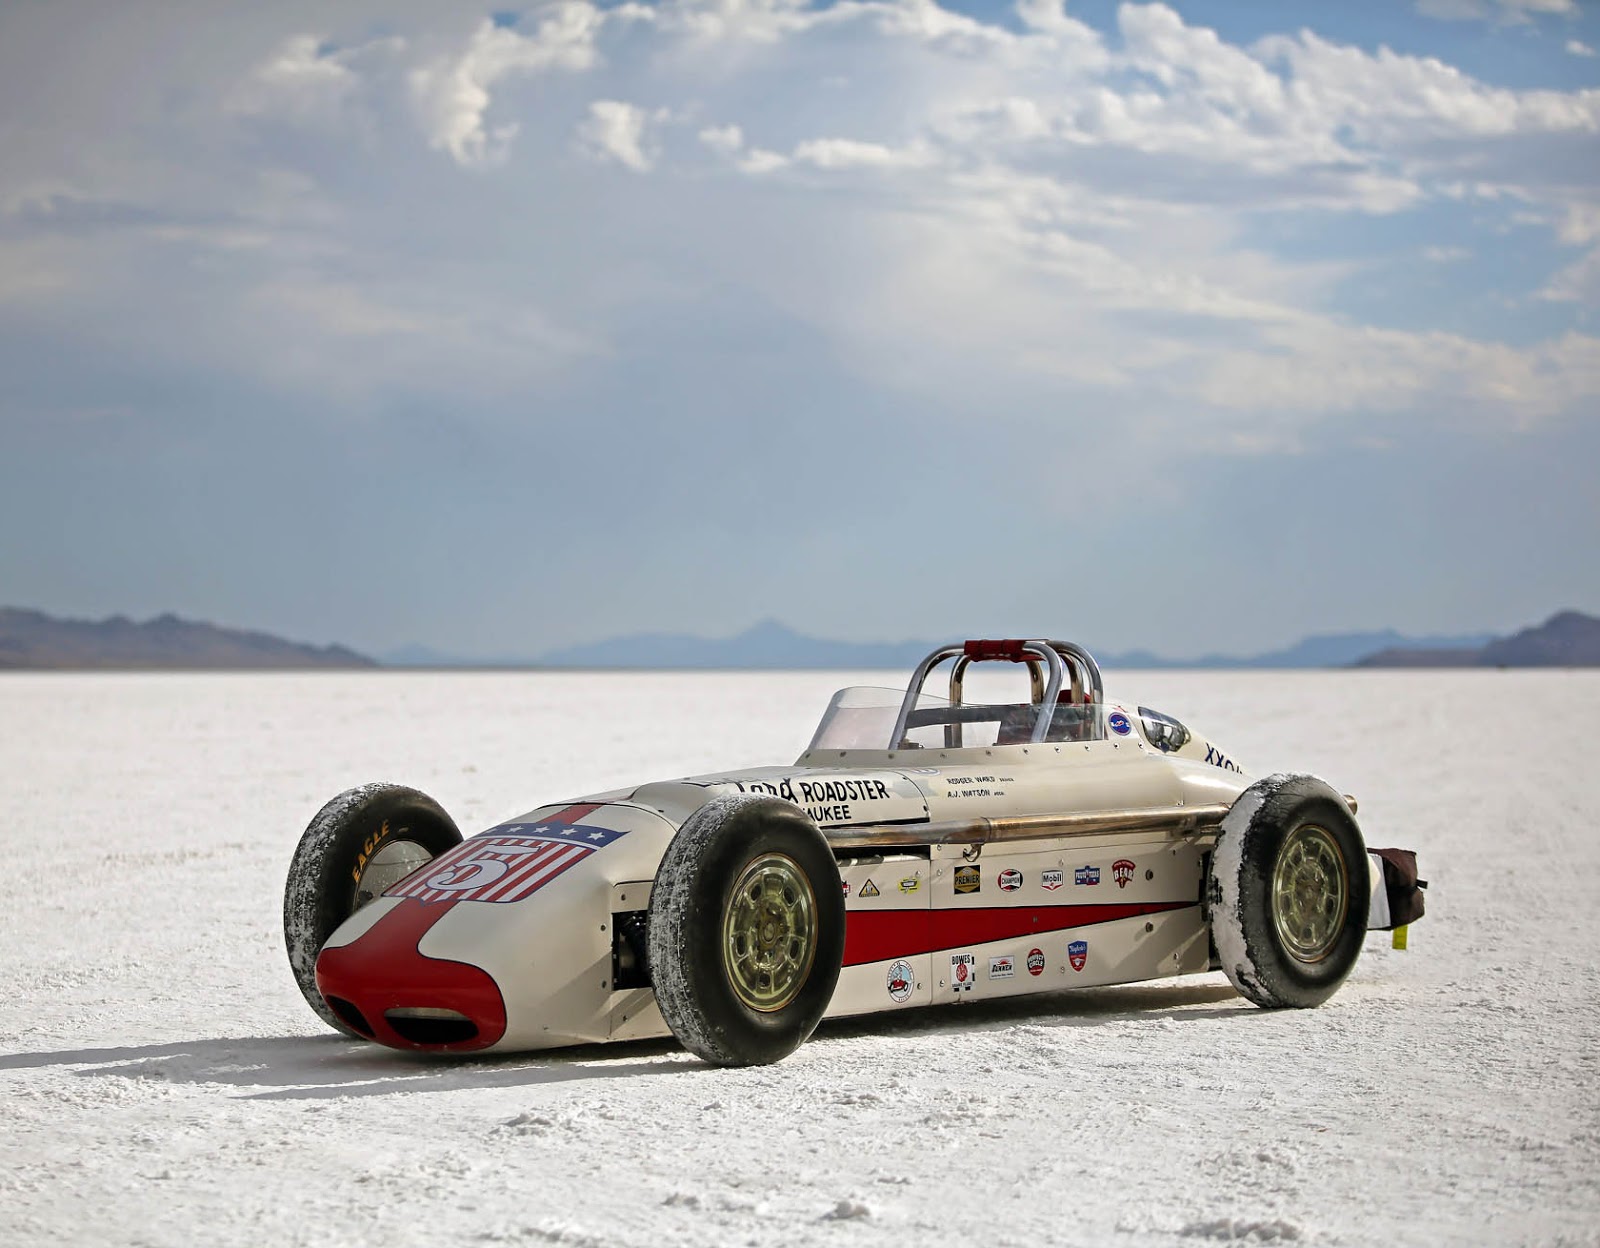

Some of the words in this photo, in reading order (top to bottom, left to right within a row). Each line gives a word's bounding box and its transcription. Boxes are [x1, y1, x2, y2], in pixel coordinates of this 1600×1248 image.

[799, 779, 890, 803] ROADSTER
[961, 789, 991, 798] WATSON
[802, 804, 852, 822] AUKEE
[352, 819, 390, 884] EAGLE
[425, 843, 542, 891] 5
[1113, 867, 1134, 881] BEAR
[954, 874, 980, 885] PREMIER
[1043, 872, 1062, 883] Mobil
[951, 954, 971, 966] BOWES
